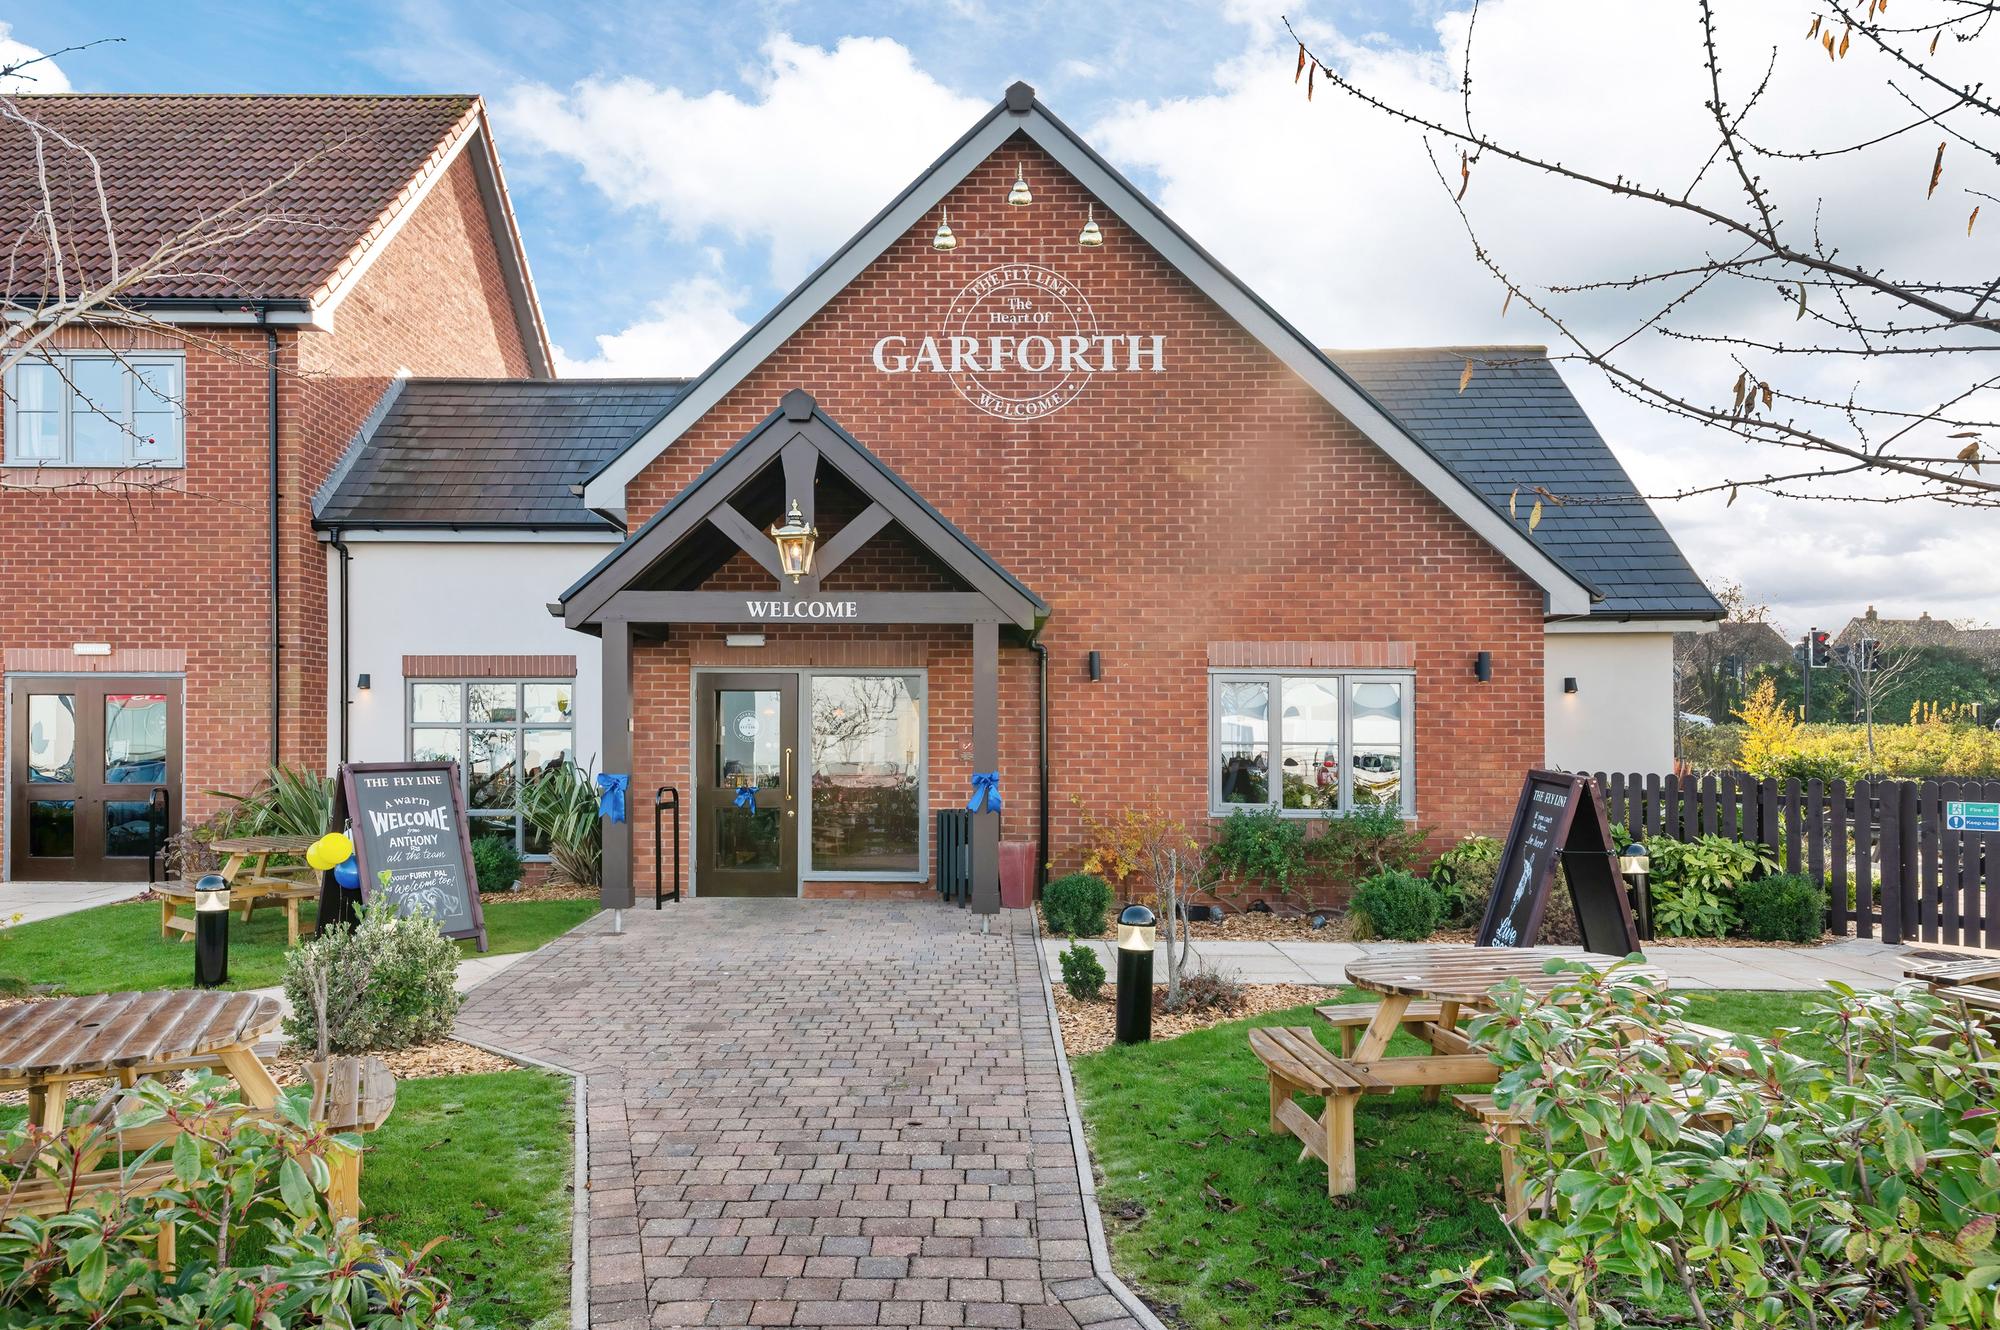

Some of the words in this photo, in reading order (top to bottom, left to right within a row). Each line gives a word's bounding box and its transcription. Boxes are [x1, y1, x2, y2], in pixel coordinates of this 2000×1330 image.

[969, 273, 1000, 296] THE
[1004, 269, 1032, 281] FLY
[1036, 271, 1070, 297] LINE
[1008, 297, 1033, 310] The
[990, 312, 1029, 324] Heart
[1033, 311, 1052, 323] Of
[872, 333, 1167, 374] GARFORTH
[979, 392, 1063, 416] WELCOME
[746, 601, 858, 618] WELCOME
[364, 778, 389, 788] THE
[393, 777, 414, 786] FLY
[416, 776, 442, 785] LINE
[394, 796, 430, 807] warm
[1533, 790, 1545, 802] THE
[368, 806, 450, 837] WELCOME
[389, 834, 438, 848] ANTHONY
[387, 851, 403, 863] all
[405, 850, 421, 860] the
[423, 848, 446, 859] team
[409, 870, 432, 880] FURRY
